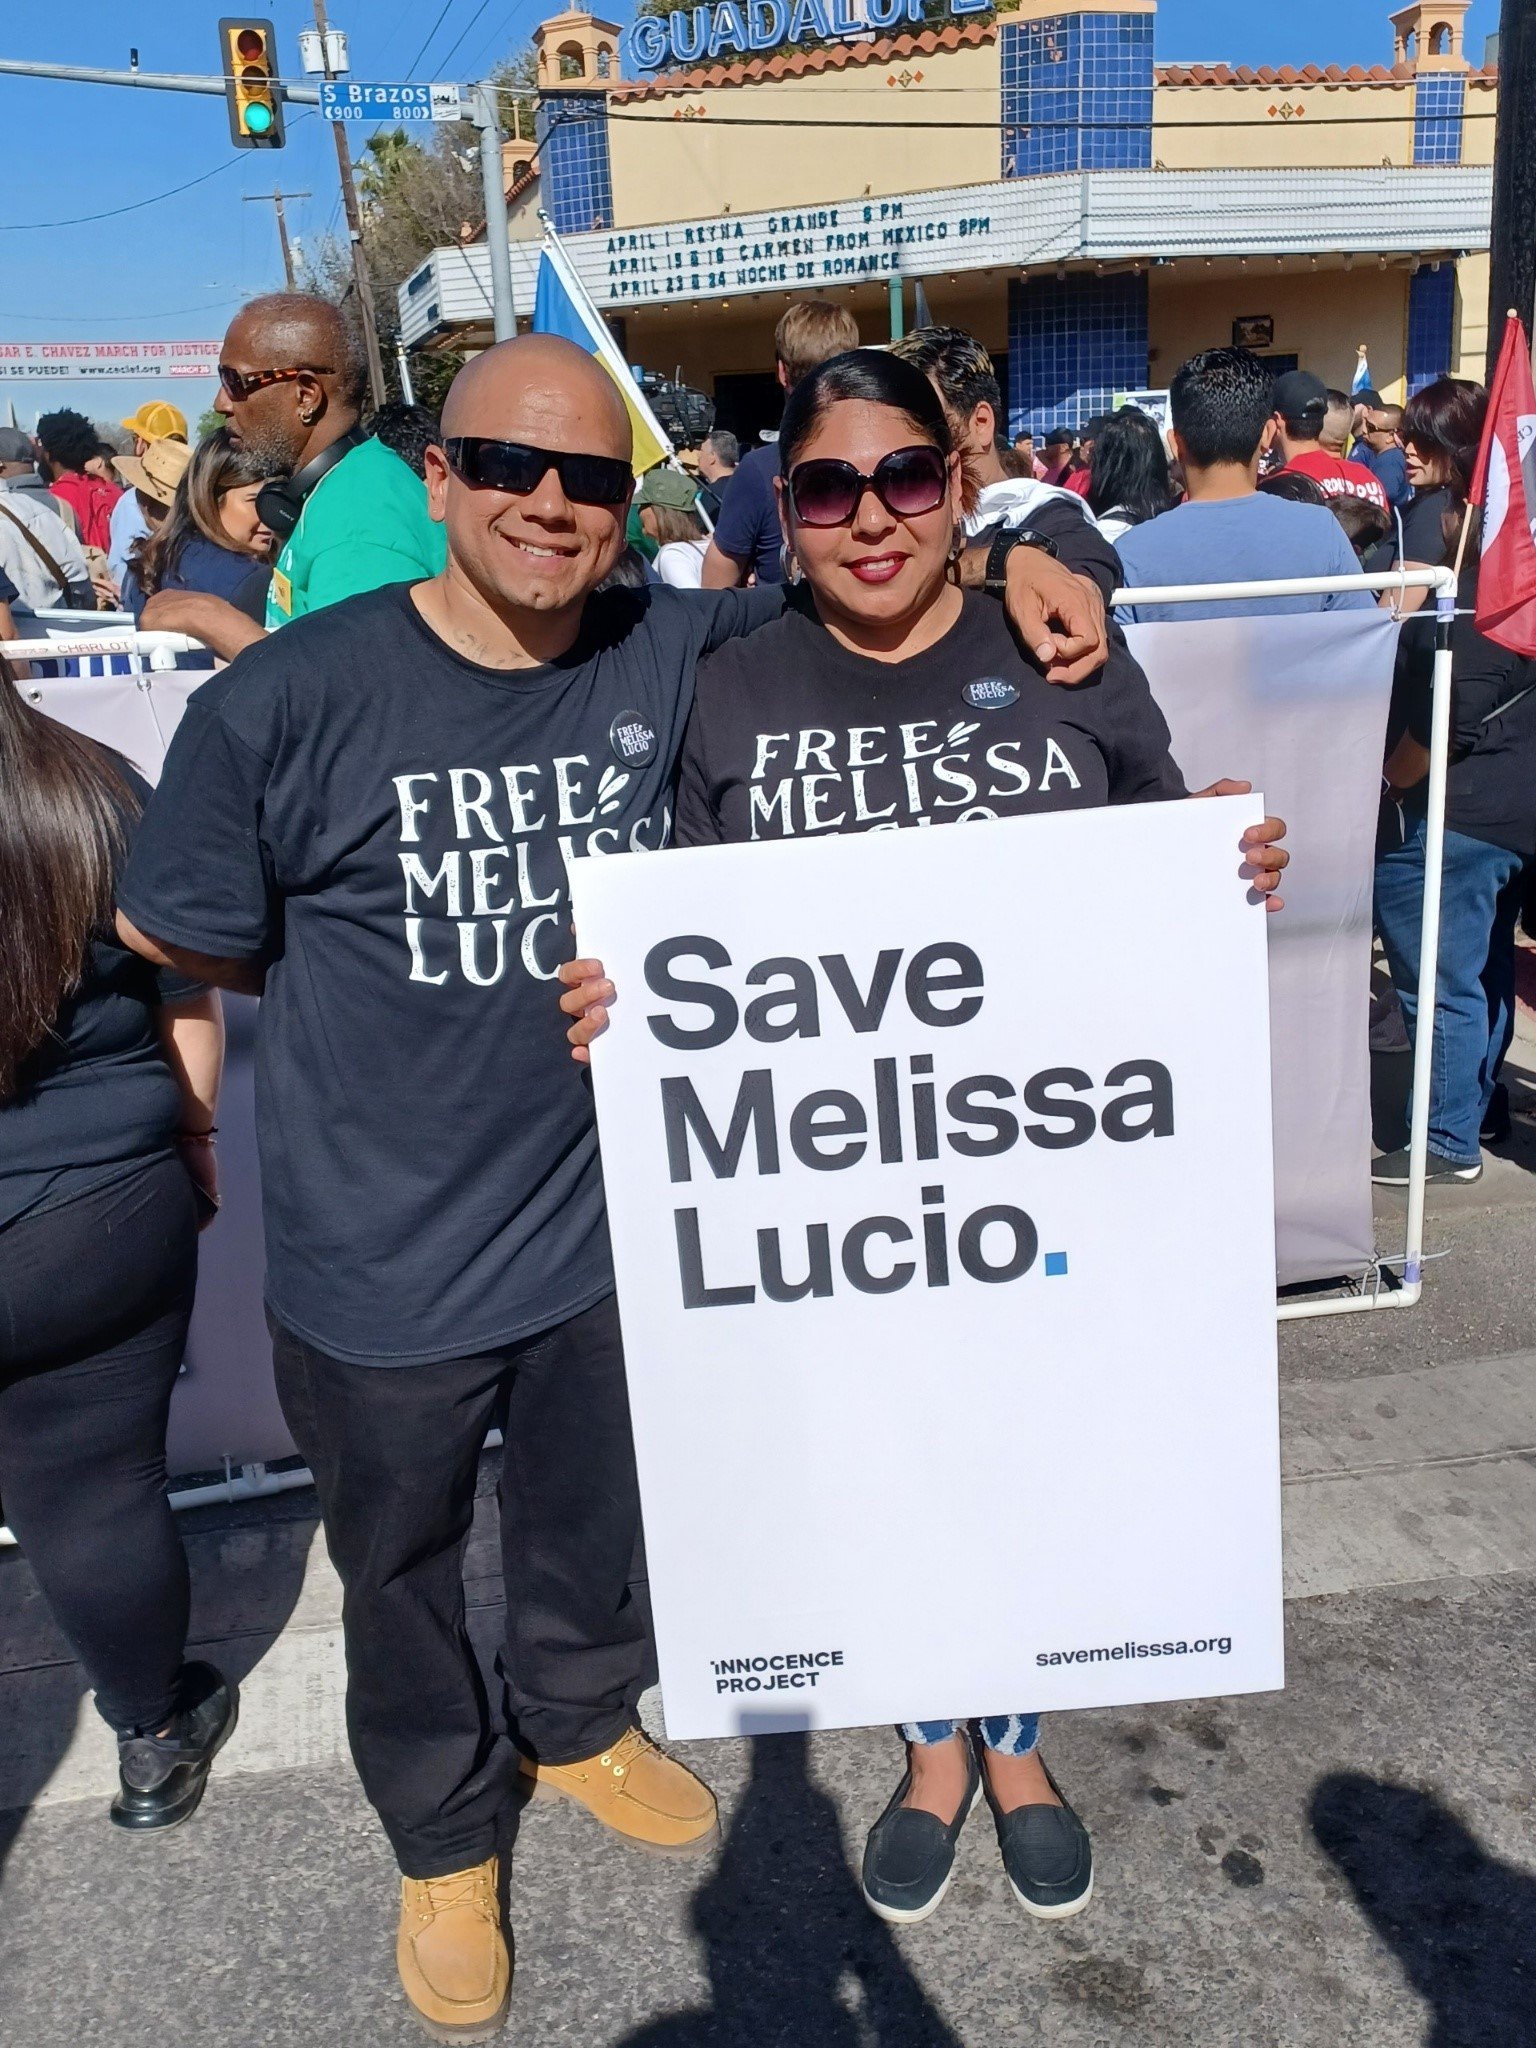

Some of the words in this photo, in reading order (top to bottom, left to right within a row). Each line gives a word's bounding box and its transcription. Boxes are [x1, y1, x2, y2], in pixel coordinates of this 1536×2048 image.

[628, 0, 993, 68] GUADALU
[323, 84, 337, 103] S
[348, 84, 428, 103] Brazos
[334, 106, 363, 119] 900
[392, 106, 421, 119] 800
[607, 233, 656, 254] APRIL
[685, 221, 744, 245] REYNA
[768, 209, 838, 234] GRANDE
[880, 202, 903, 221] PM
[609, 256, 657, 276] APRIL
[740, 237, 814, 261] CARMEN
[826, 231, 869, 252] FROM
[883, 222, 947, 245] MEXICO
[610, 279, 659, 298] APRIL
[736, 263, 786, 285] NOCHE
[797, 261, 814, 279] DE
[824, 251, 900, 277] ROMANCE
[42, 346, 91, 358] CHAVEZ
[95, 345, 138, 358] MARCH
[143, 345, 166, 357] FOR
[171, 344, 220, 357] JUSTICE
[617, 723, 638, 738] FREE
[620, 729, 655, 746] MELISSA
[622, 740, 649, 756] LUCIO
[750, 720, 945, 779] FREE
[392, 754, 597, 842] FREE
[749, 737, 1082, 840] MELISSA
[405, 910, 566, 986] LUC
[643, 934, 985, 1051] Save
[659, 1053, 1175, 1183] Melissa
[673, 1184, 1068, 1310] Lucio.
[710, 1651, 844, 1675] INNOCENCE
[1035, 1636, 1232, 1667] savemelisssa.org
[716, 1672, 820, 1694] PROJECT
